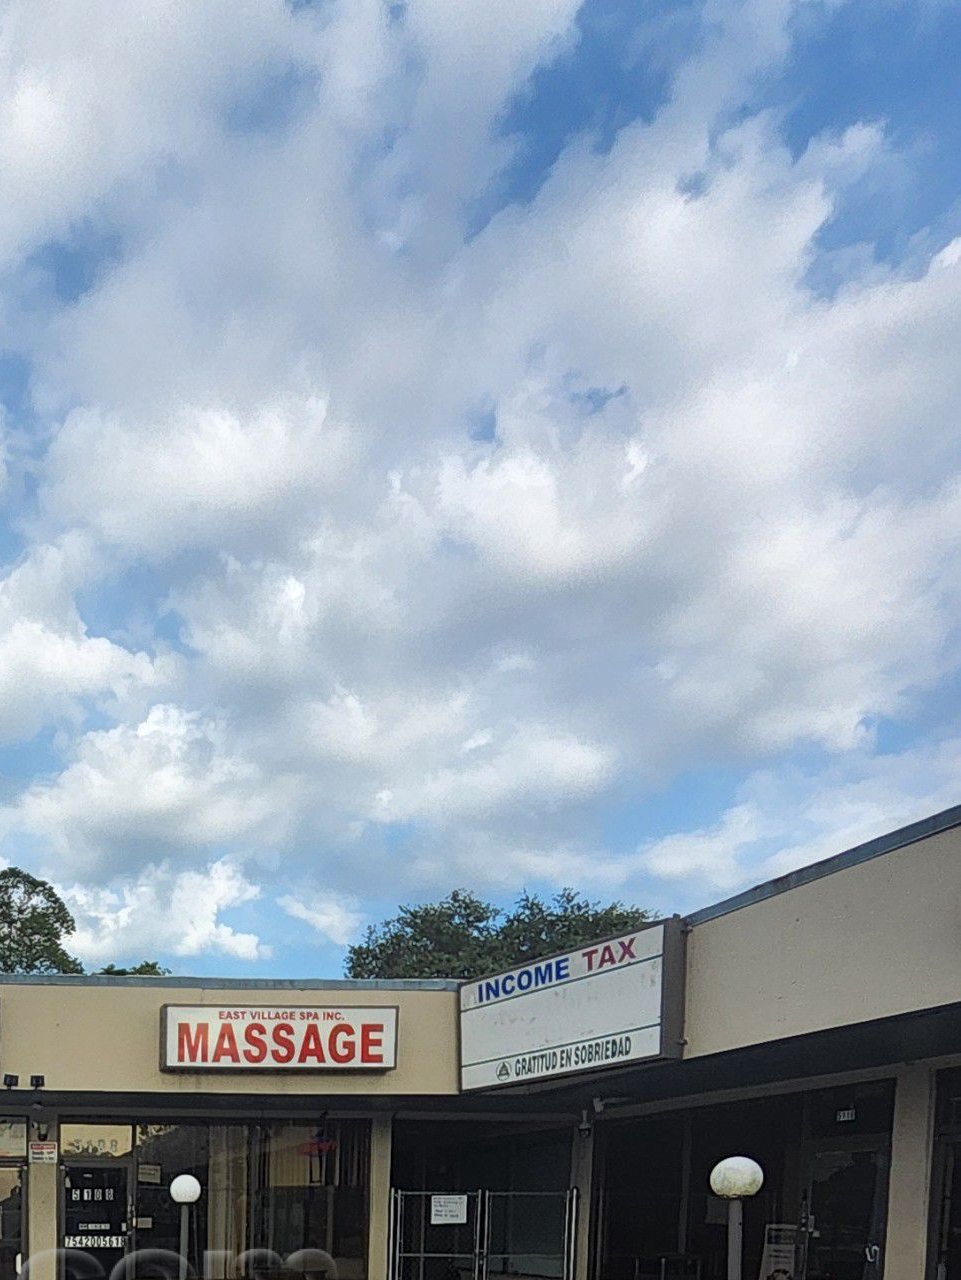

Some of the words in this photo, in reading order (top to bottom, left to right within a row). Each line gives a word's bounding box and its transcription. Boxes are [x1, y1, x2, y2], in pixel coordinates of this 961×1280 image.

[478, 958, 570, 1003] INCOME
[582, 938, 637, 972] TAX
[219, 1011, 246, 1020] EAST
[250, 1011, 296, 1021] VILLAGE
[299, 1012, 319, 1021] SPA
[323, 1012, 344, 1021] INC.
[177, 1023, 384, 1064] MASSAGE
[515, 1051, 557, 1076] GRATITUD
[560, 1049, 572, 1069] EN
[574, 1036, 631, 1066] SOBRIEDAD
[71, 1188, 114, 1201] 5108
